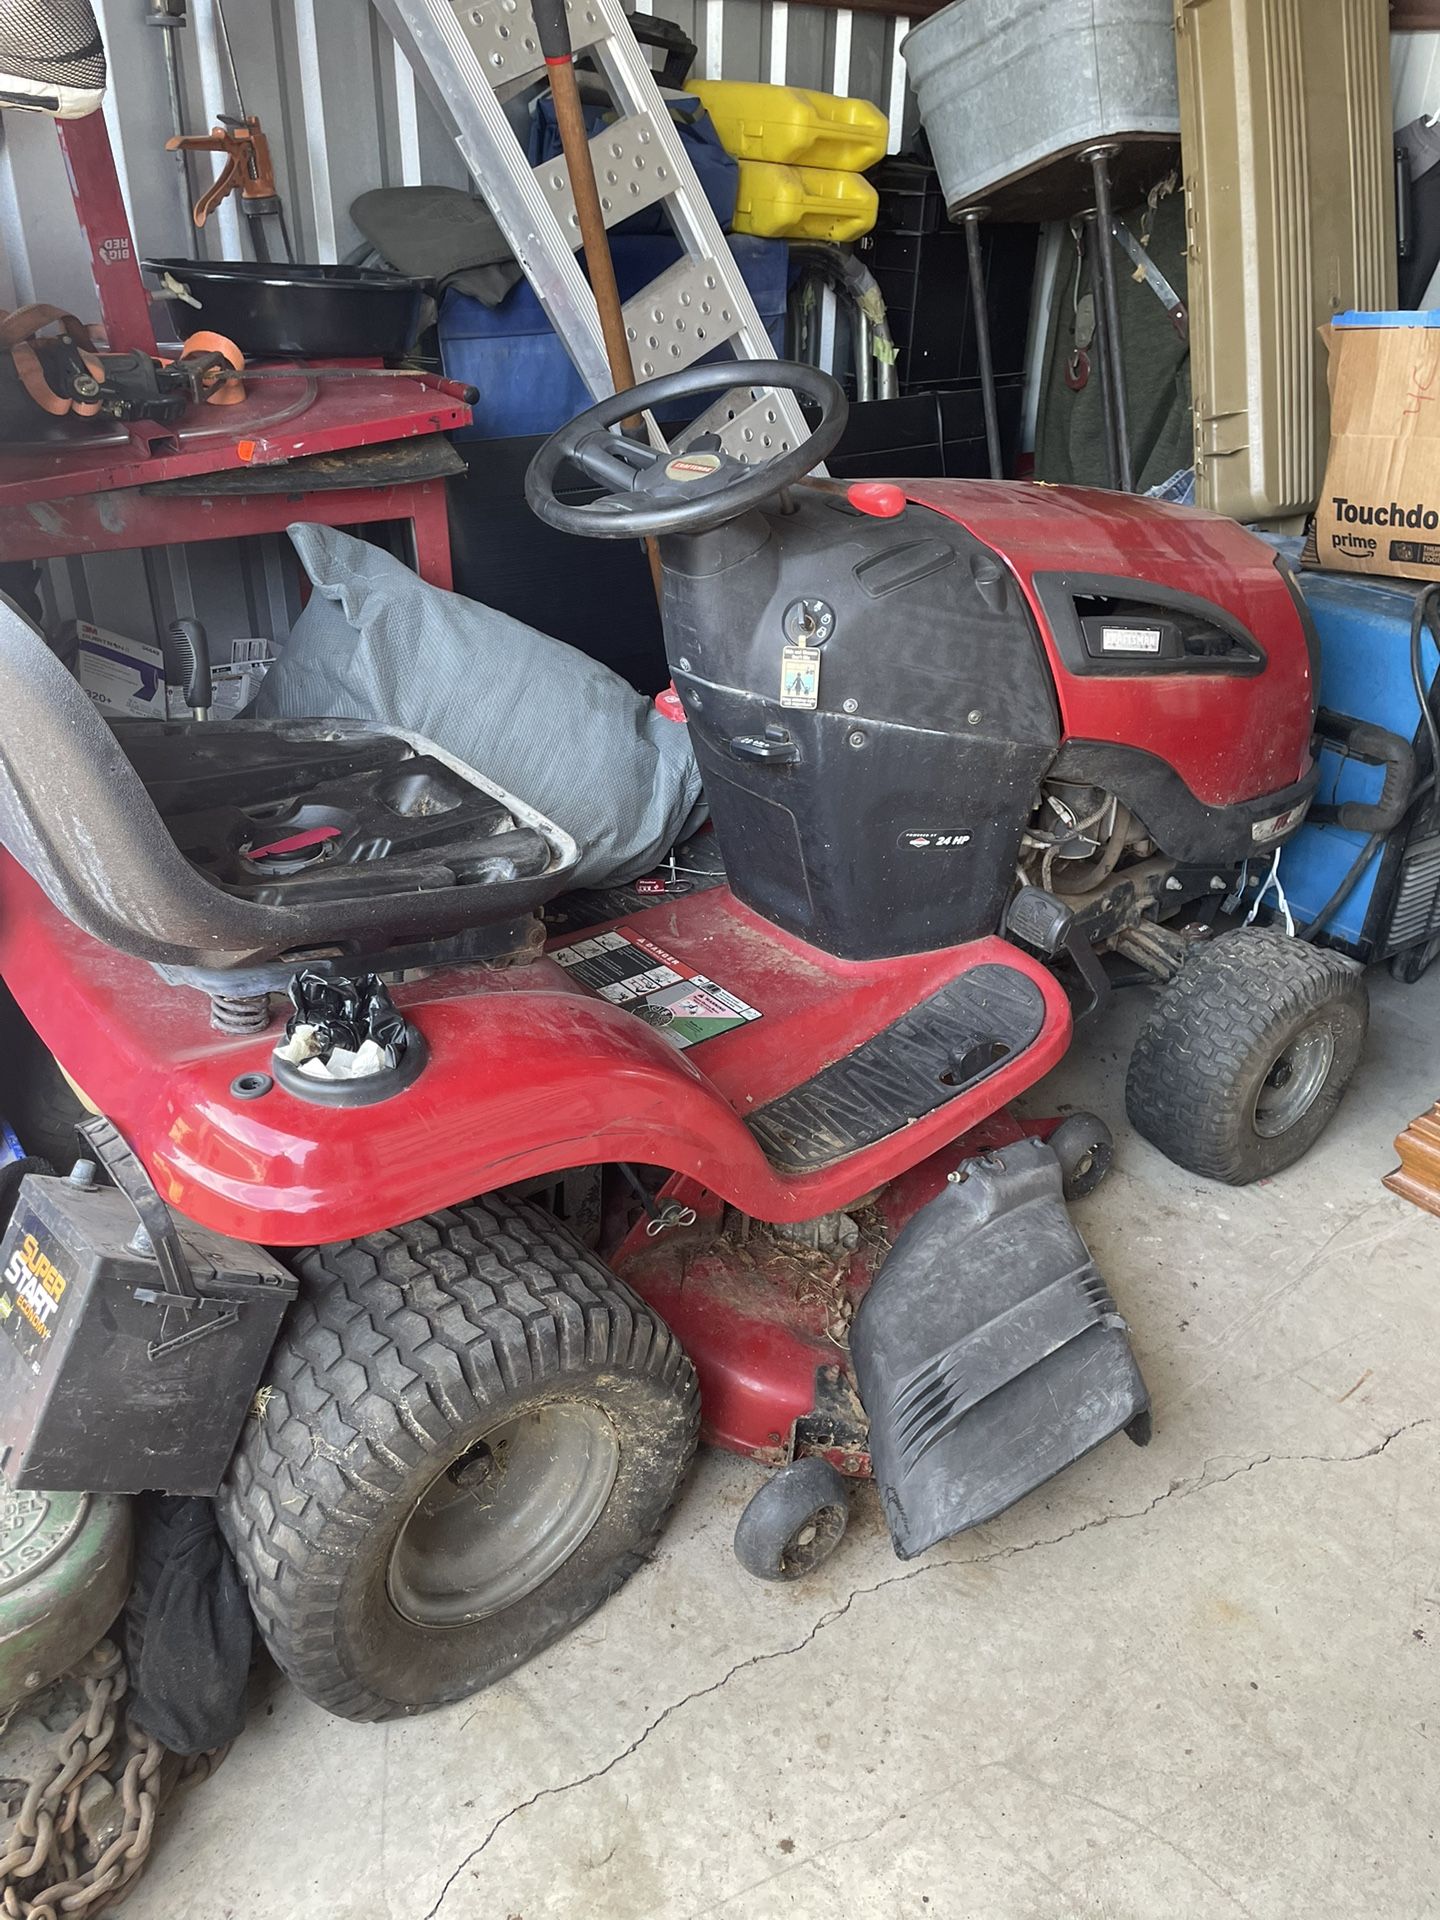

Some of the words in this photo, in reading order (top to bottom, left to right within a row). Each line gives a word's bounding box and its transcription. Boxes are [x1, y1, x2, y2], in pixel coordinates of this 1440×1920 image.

[104, 238, 128, 250] RED
[109, 249, 129, 260] BIG
[1332, 497, 1439, 530] Touchdo
[1332, 533, 1377, 550] prime
[82, 624, 98, 636] 3M
[935, 836, 953, 846] 24
[952, 835, 970, 846] HP
[645, 942, 680, 965] DANGER
[19, 1233, 67, 1303] SUPER
[4, 1249, 59, 1323] START
[16, 1295, 49, 1340] ECONOMY
[4, 1500, 43, 1517] DEL
